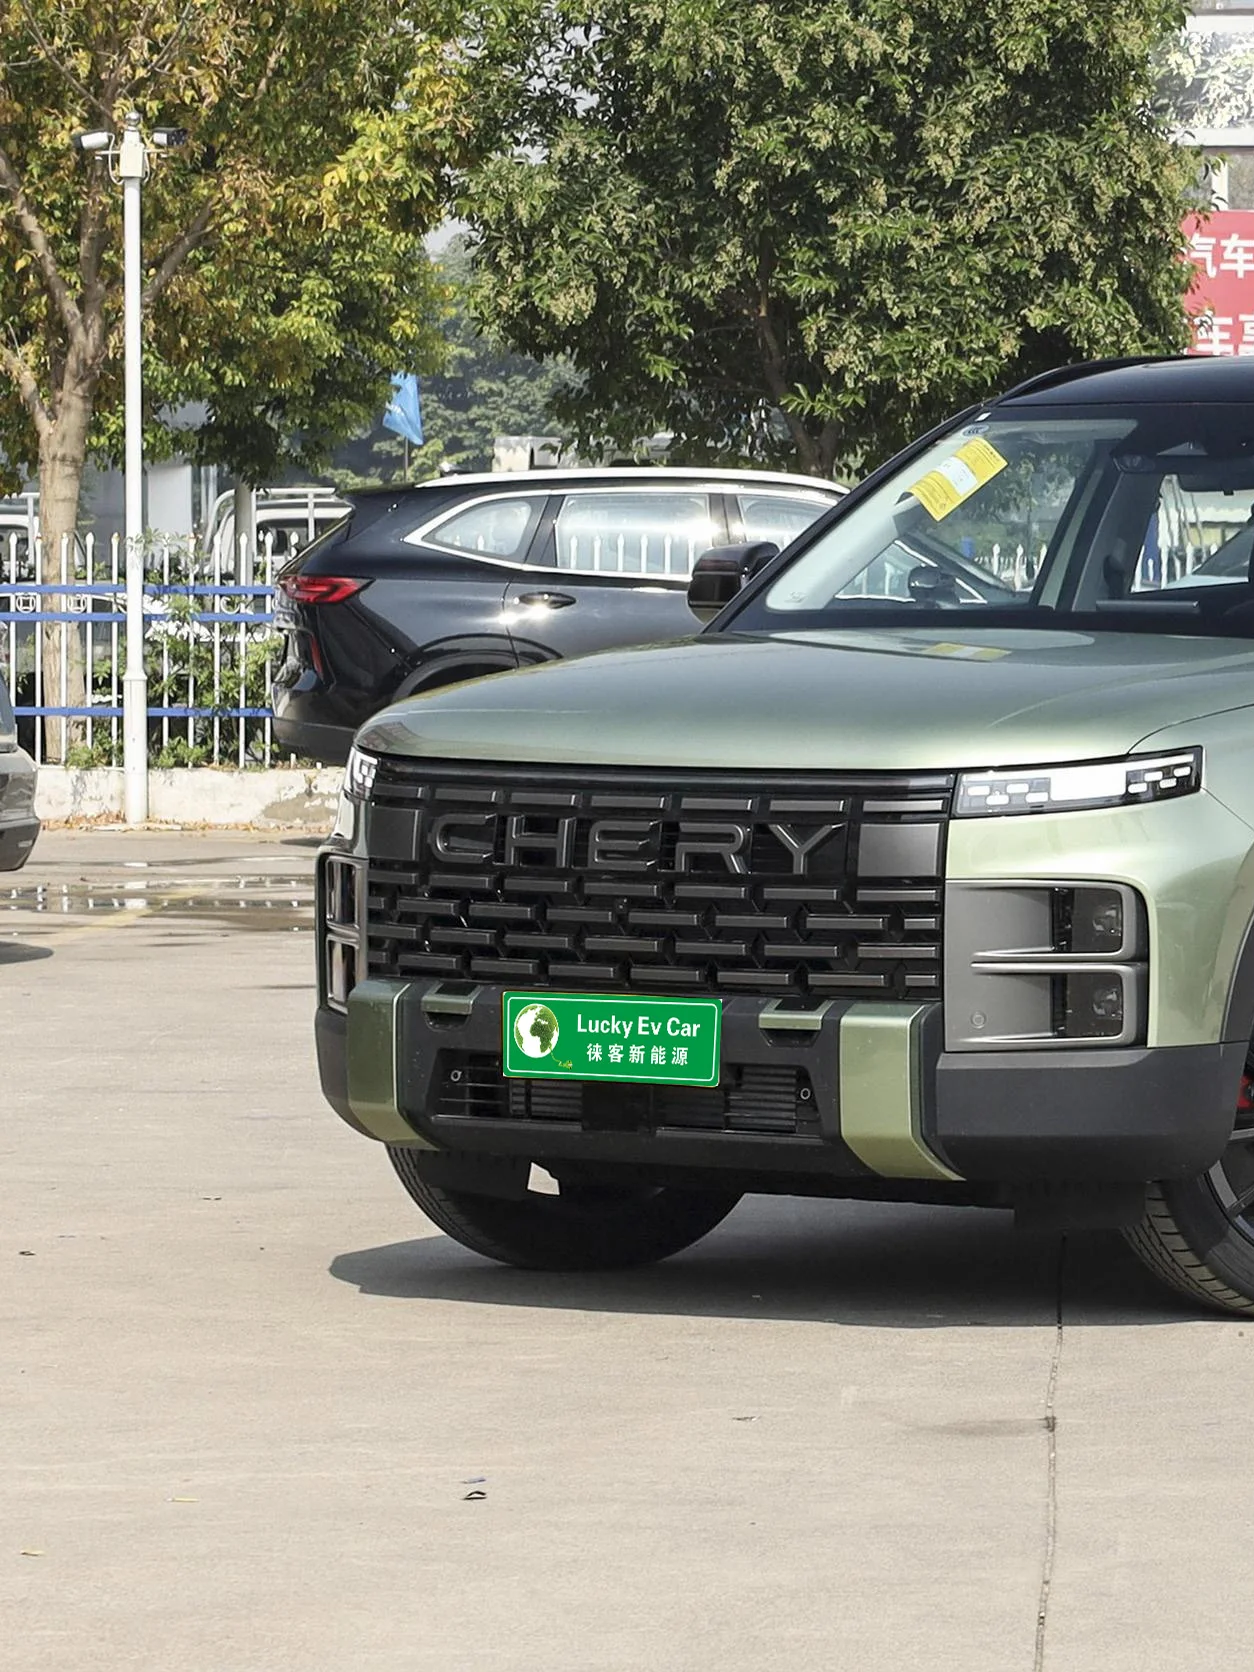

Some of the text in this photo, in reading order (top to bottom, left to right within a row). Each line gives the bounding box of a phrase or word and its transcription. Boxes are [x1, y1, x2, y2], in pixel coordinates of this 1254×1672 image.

[432, 813, 847, 876] CHERY
[577, 1014, 701, 1039] Lucky Ev Car
[586, 1043, 689, 1066] 徕客新能源
